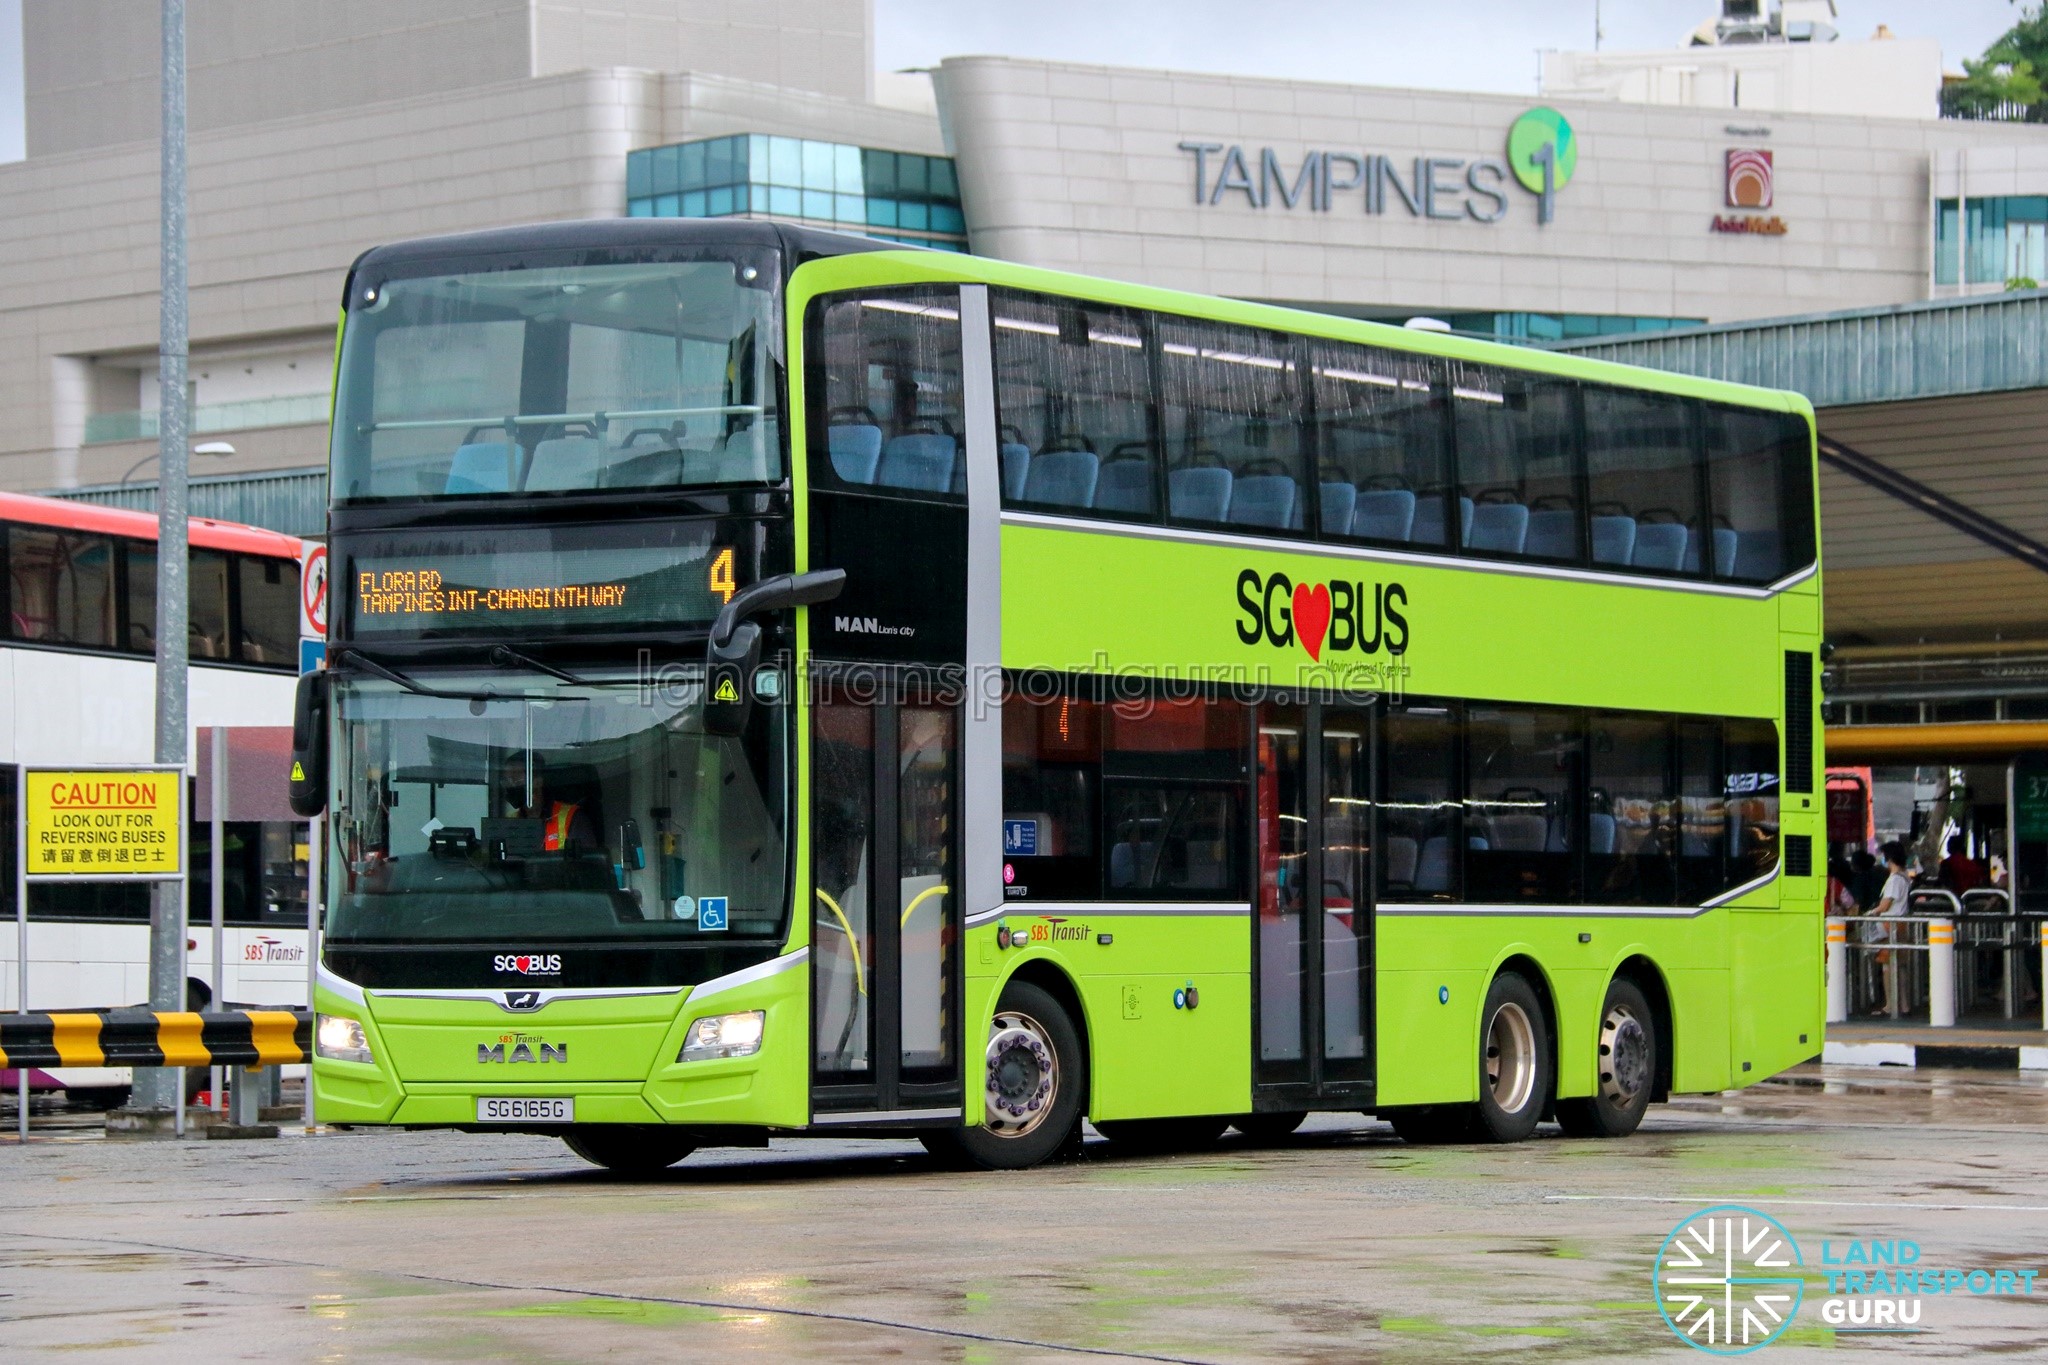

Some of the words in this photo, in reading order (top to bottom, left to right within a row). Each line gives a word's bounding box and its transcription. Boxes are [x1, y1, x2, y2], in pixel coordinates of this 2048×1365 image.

[1178, 140, 1508, 223] TAMPINES
[1529, 141, 1555, 226] 1
[360, 571, 416, 593] FLORA
[419, 570, 442, 591] RD
[711, 549, 735, 604] 4
[360, 590, 445, 613] TAMPINES
[554, 587, 588, 608] NTH
[592, 585, 626, 607] WAY
[835, 616, 878, 633] MAN
[900, 626, 915, 637] City
[1326, 659, 1352, 677] Moving
[51, 783, 156, 805] CAUTION
[53, 815, 91, 828] LOOK
[95, 815, 122, 828] OUT
[126, 815, 153, 827] FOR
[41, 831, 118, 845] REVERSING
[122, 831, 166, 844] BUSES
[42, 849, 165, 863] 请留意倒退巴士
[1031, 924, 1049, 941] SBS
[1047, 918, 1092, 943] Transit
[245, 944, 263, 960] SBS
[263, 940, 304, 963] Transit
[499, 1035, 513, 1043] SBS
[513, 1033, 544, 1044] Transit
[477, 1043, 567, 1063] MAN
[487, 1101, 564, 1118] SG6165G
